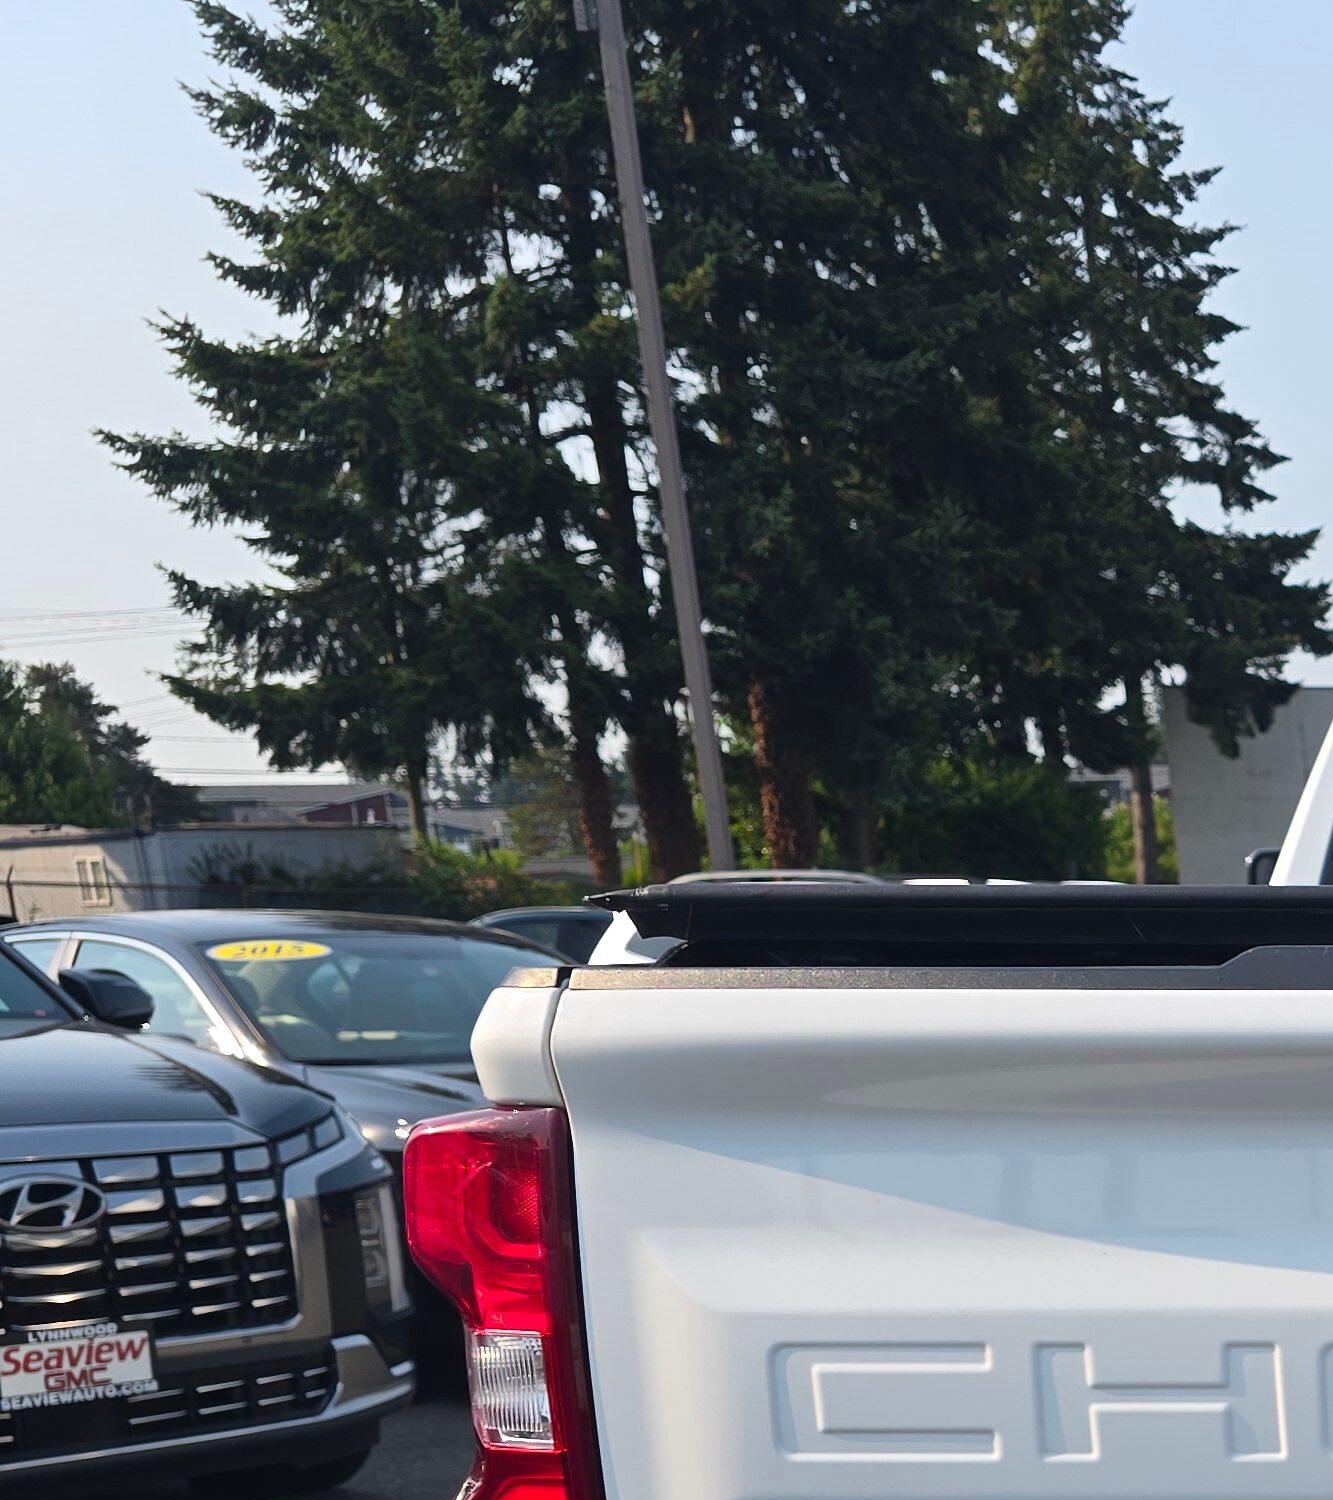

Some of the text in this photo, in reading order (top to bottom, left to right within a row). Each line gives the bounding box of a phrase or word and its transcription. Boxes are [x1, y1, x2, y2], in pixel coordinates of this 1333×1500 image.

[28, 1322, 118, 1343] LYNNWOOD
[1, 1337, 148, 1376] Seaview
[44, 1365, 112, 1391] GMC
[0, 1379, 159, 1411] SEAVIEWAUTO.COM
